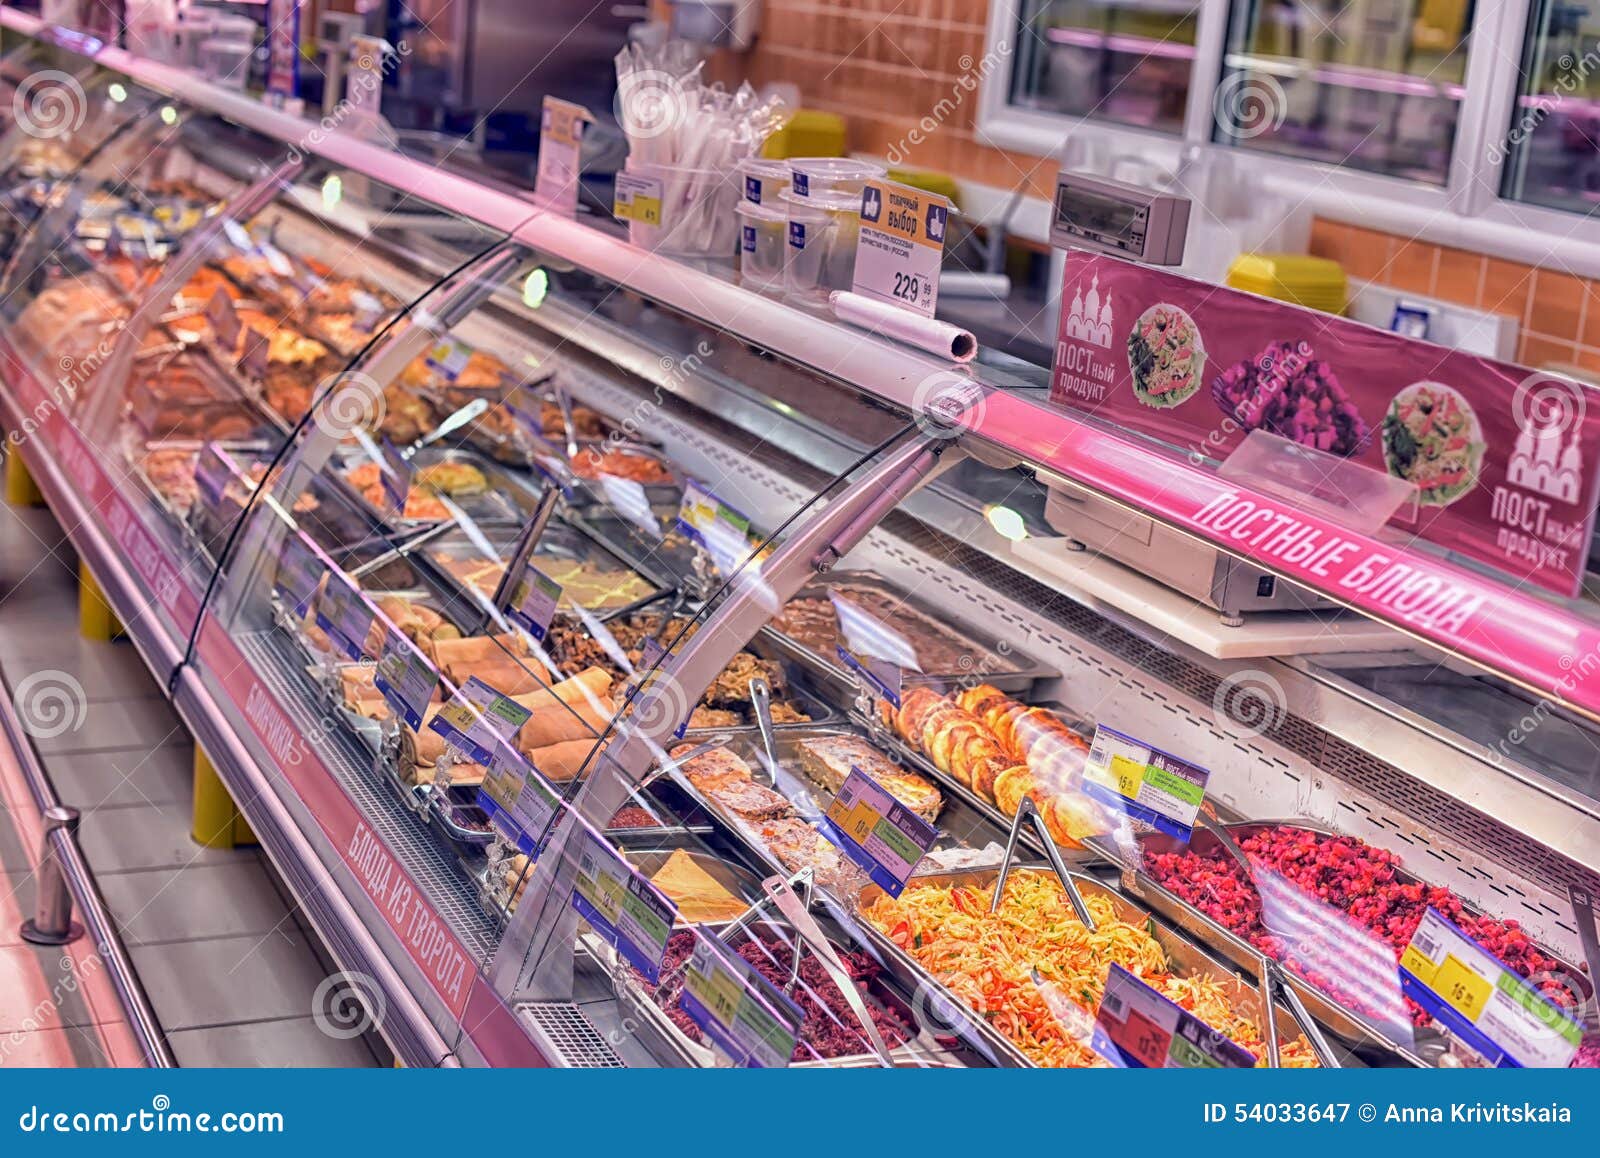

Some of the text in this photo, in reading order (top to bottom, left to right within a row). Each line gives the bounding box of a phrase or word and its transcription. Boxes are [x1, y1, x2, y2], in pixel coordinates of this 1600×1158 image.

[888, 209, 917, 237] выбор
[893, 271, 918, 302] 229
[1056, 341, 1115, 383] ПОСТный
[1060, 372, 1106, 400] продукт
[1192, 489, 1490, 634] ПОСТНЫЕ БЛЮДА
[1497, 527, 1569, 570] продукт
[348, 822, 466, 1002] БЛЮДА ИЗ ТВОРОГА
